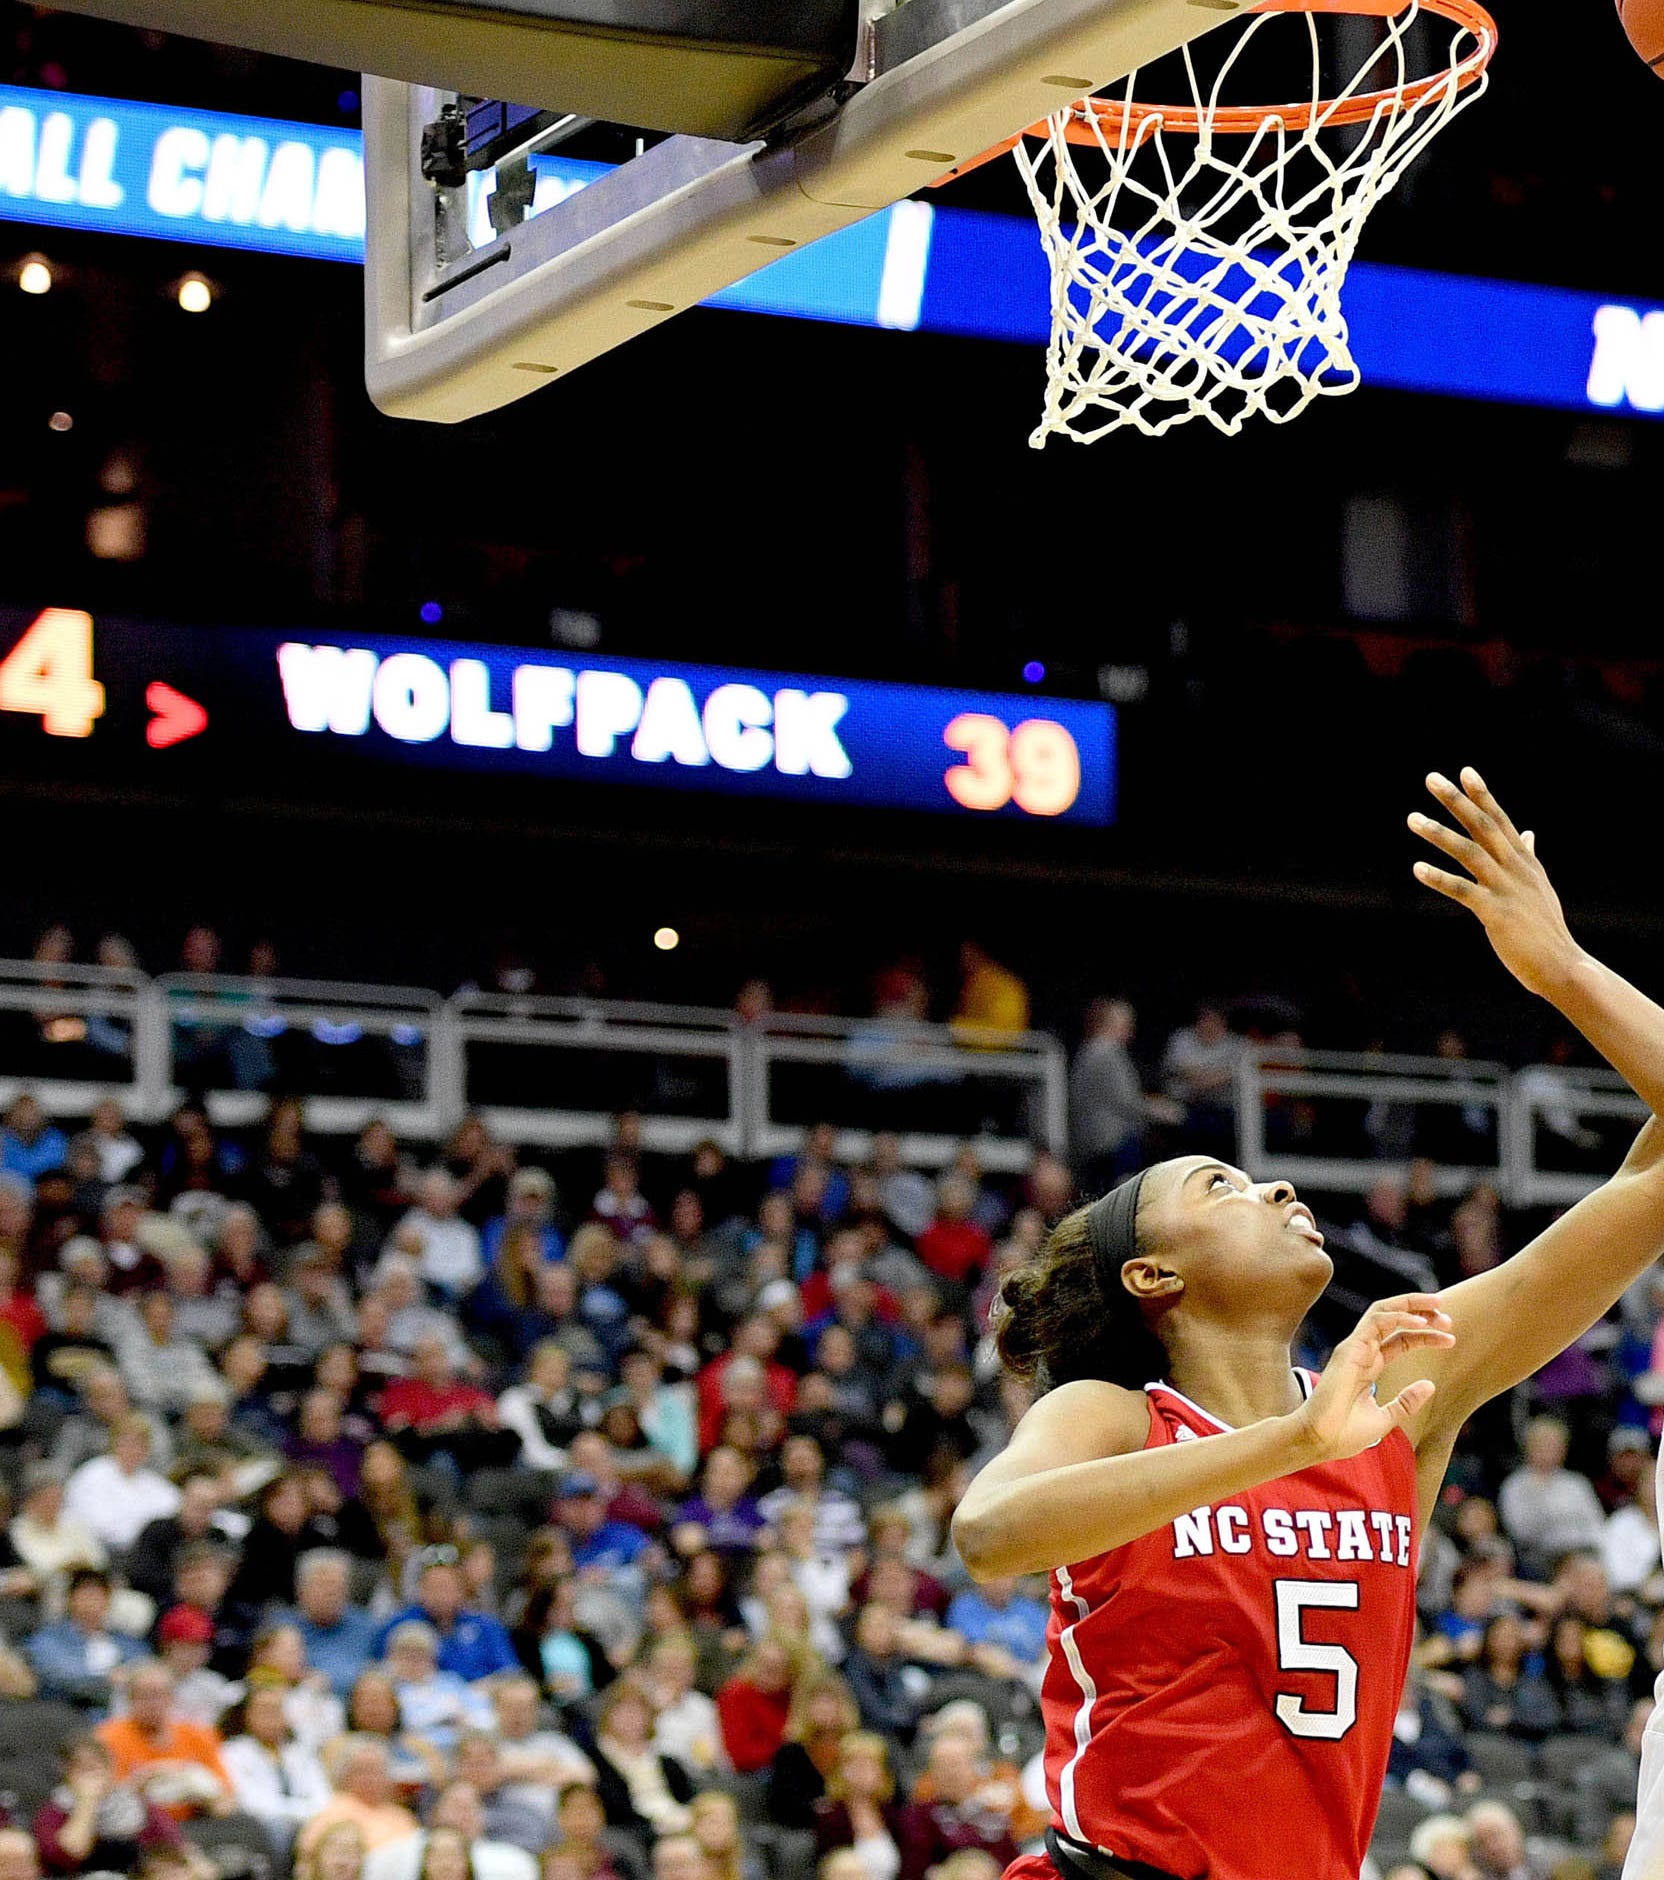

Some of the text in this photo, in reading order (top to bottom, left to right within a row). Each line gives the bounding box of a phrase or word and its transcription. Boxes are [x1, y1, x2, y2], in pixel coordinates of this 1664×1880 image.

[0, 607, 105, 737] 4
[277, 642, 1081, 816] WOLFPACK 39
[1173, 1505, 1411, 1567] NC STATE
[1273, 1578, 1359, 1741] 5
